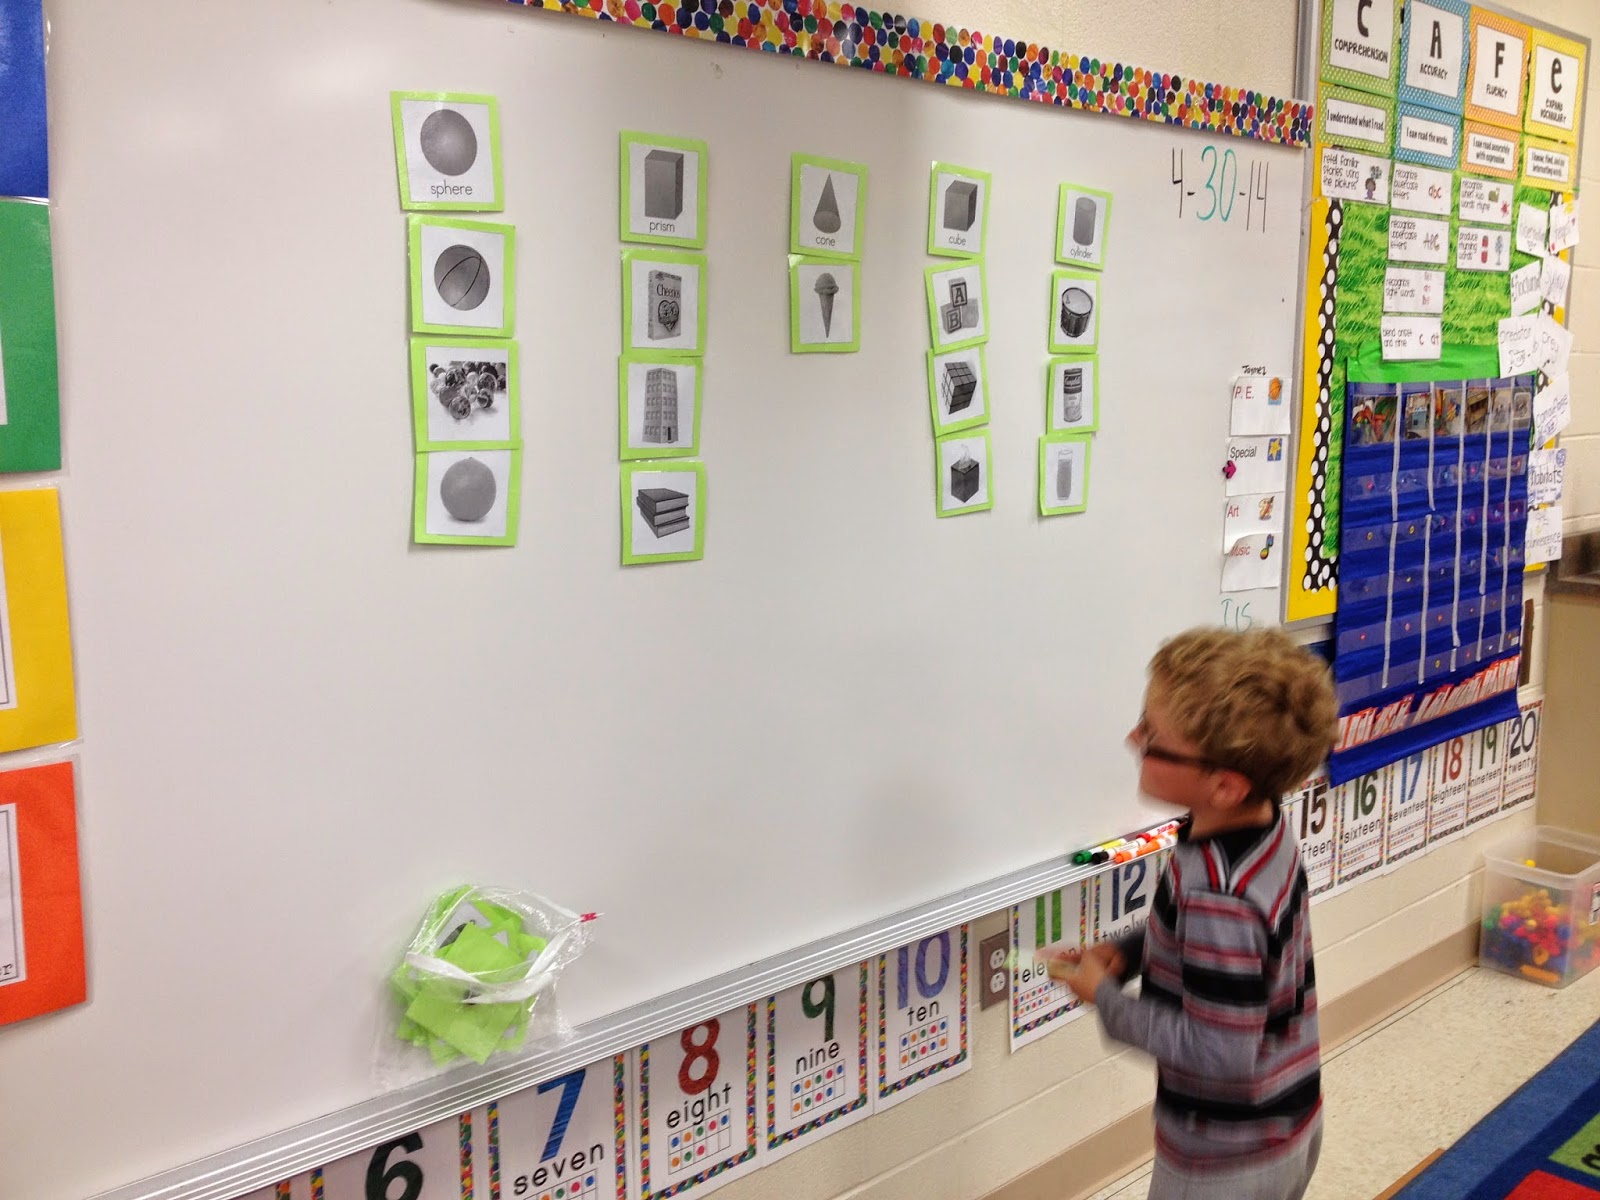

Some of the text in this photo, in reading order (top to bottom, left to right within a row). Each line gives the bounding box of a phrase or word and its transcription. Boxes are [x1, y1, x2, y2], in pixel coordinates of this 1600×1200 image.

[1358, 0, 1372, 38] C
[1430, 21, 1442, 59] A
[1420, 64, 1448, 80] ACCURACY
[1494, 42, 1505, 78] F
[1486, 84, 1508, 98] FLUENCY
[1330, 112, 1358, 126] understand
[1359, 116, 1371, 128] what
[1409, 130, 1418, 138] can
[1418, 131, 1428, 141] read
[430, 179, 473, 198] sphere
[648, 220, 676, 234] prism
[815, 235, 836, 247] cone
[948, 234, 967, 247] cube
[1070, 246, 1093, 260] cylinder
[656, 284, 680, 298] Cheerios
[954, 286, 964, 303] A
[949, 312, 960, 330] B
[1230, 446, 1257, 461] Special
[1226, 506, 1239, 518] Art
[1230, 546, 1251, 558] Music
[1510, 710, 1536, 758] 20
[1442, 737, 1464, 784] 18
[1479, 726, 1497, 770] 19
[1400, 752, 1423, 805] 17
[1469, 768, 1501, 786] nineteen
[1508, 758, 1535, 776] twenty
[1353, 771, 1378, 821] 16
[1432, 782, 1466, 804] eighteen
[1300, 783, 1328, 840] 15
[1389, 799, 1428, 822] seventeen
[1344, 819, 1380, 844] sixteen
[1301, 840, 1332, 860] fteen
[1112, 858, 1147, 922] 12
[1036, 890, 1062, 950] 11
[897, 930, 950, 1010] 10
[801, 974, 836, 1043] 9
[907, 1000, 940, 1027] ten
[678, 1018, 720, 1096] 8
[795, 1041, 840, 1075] nine
[536, 1068, 587, 1164] 7
[666, 1082, 734, 1130] eight
[366, 1132, 424, 1200] 6
[512, 1140, 606, 1197] seven
